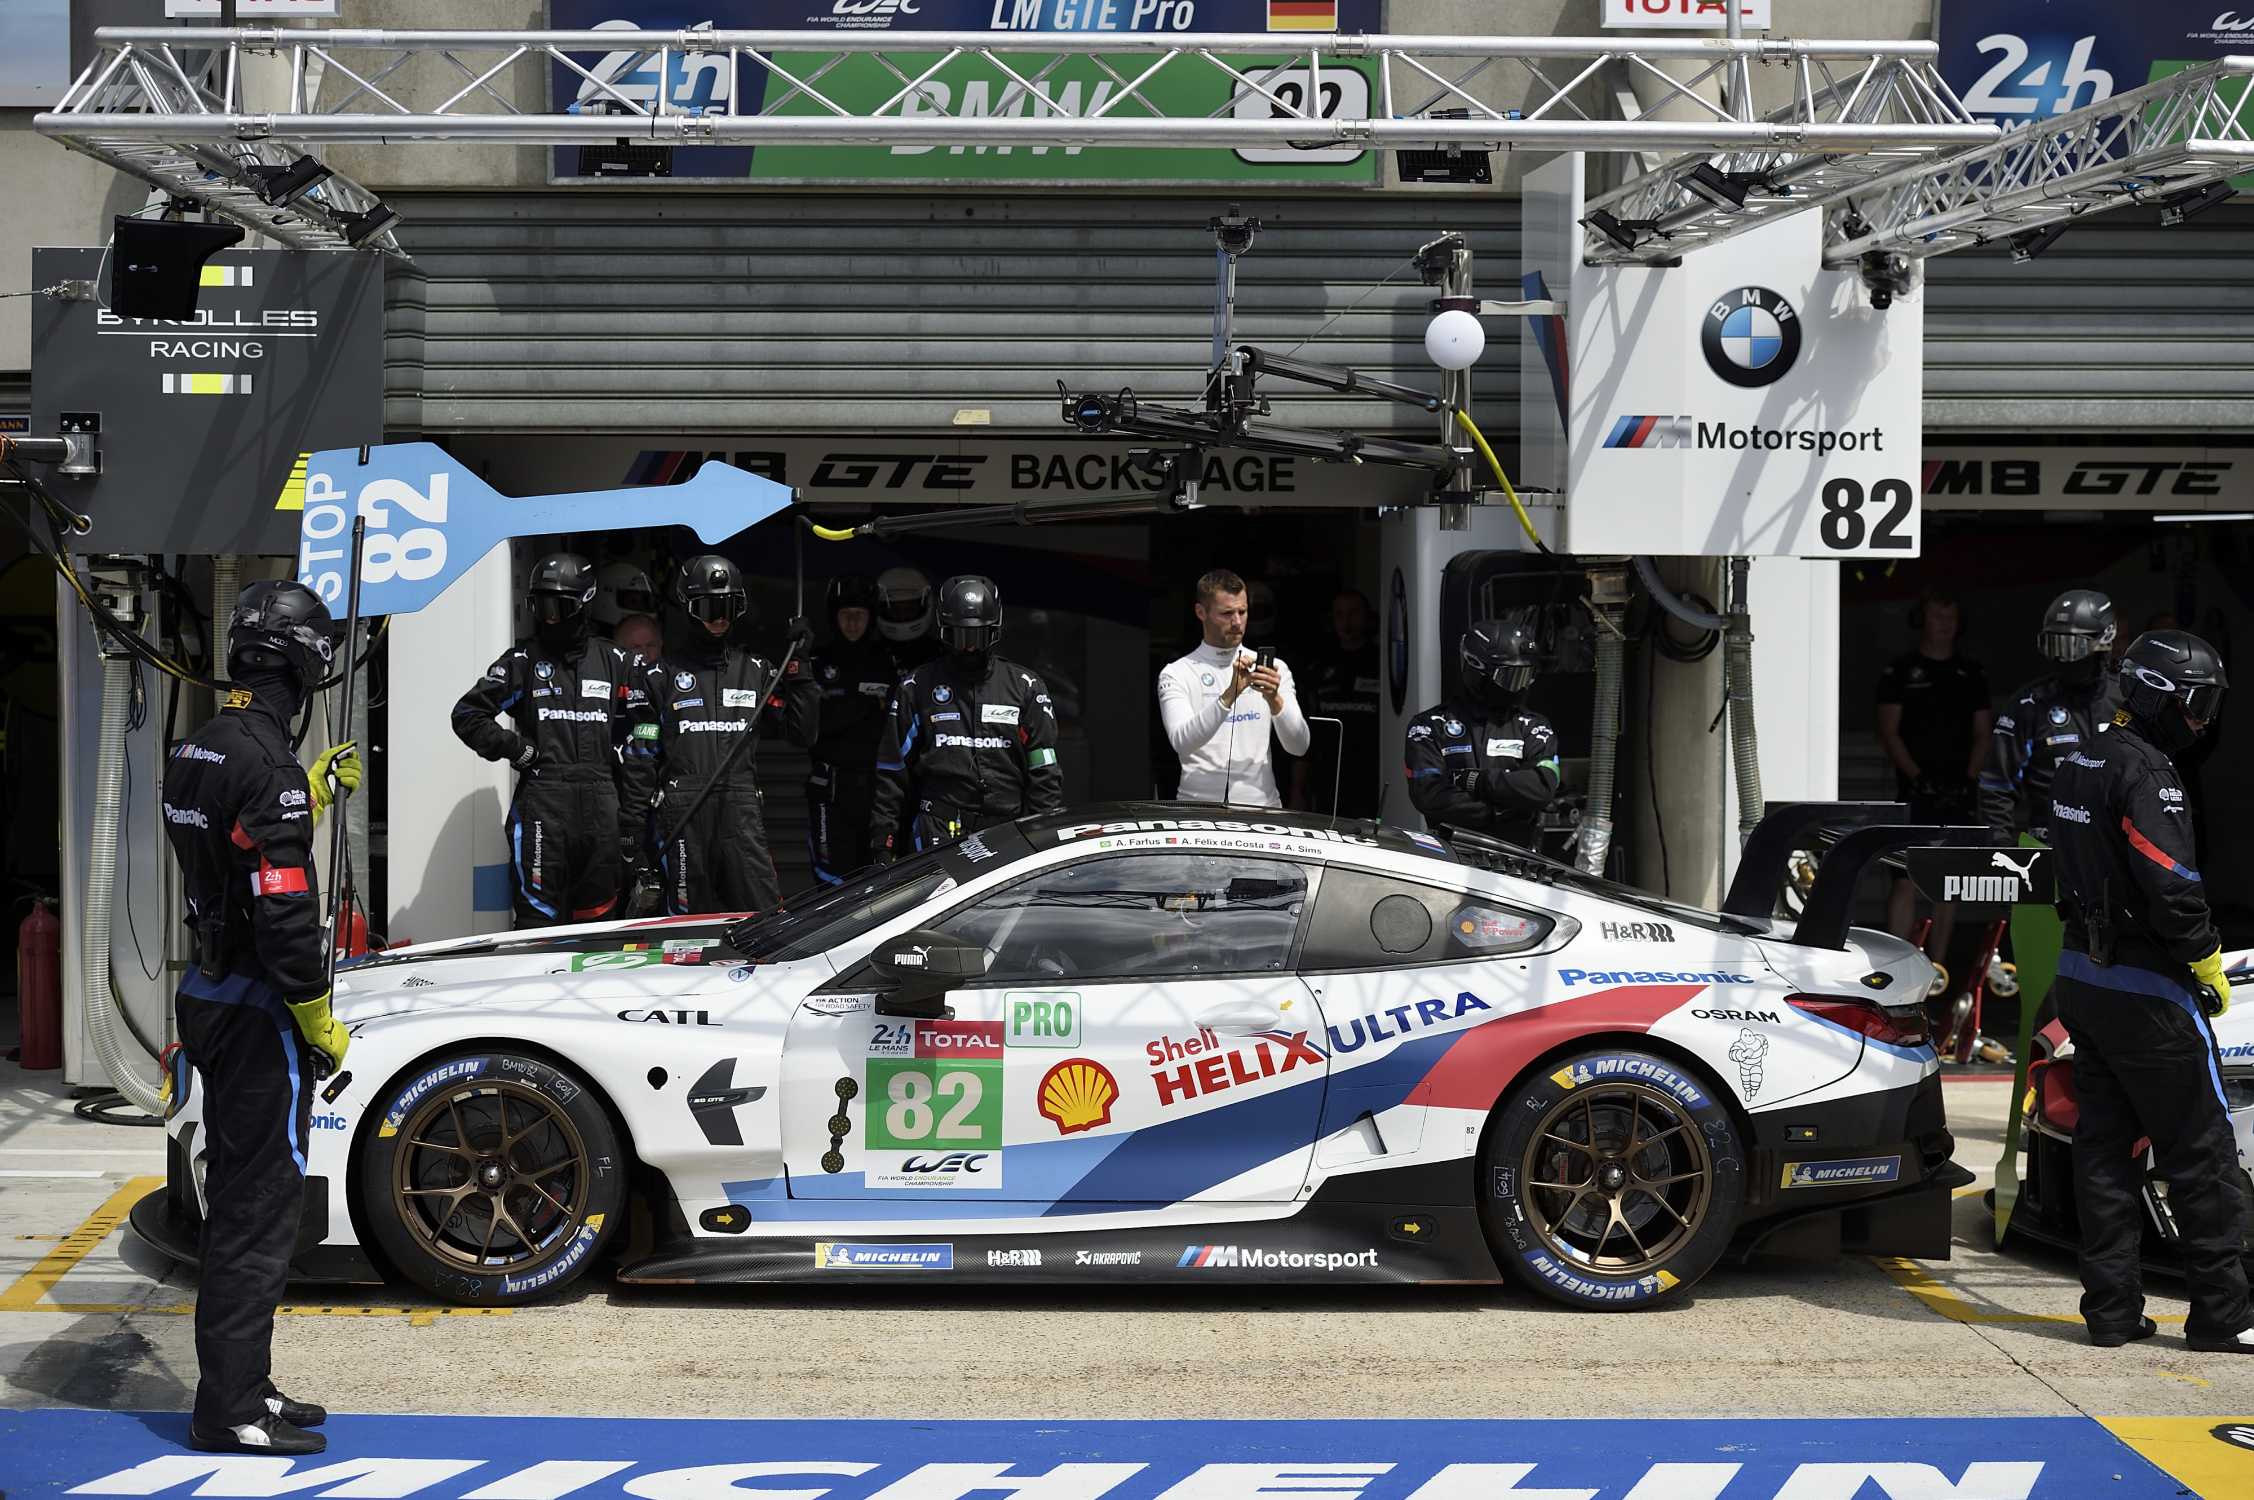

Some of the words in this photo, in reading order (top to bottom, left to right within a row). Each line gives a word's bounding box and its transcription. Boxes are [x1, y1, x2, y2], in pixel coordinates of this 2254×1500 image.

[990, 0, 1039, 30] LM
[1053, 0, 1117, 30] GTE
[1130, 0, 1195, 30] Pro
[1961, 33, 2114, 114] 24h
[1709, 289, 1796, 323] BMW
[151, 342, 264, 358] RACING
[1698, 422, 1883, 456] Motorsport
[809, 454, 987, 488] GTE
[1011, 453, 1295, 493] BACKSAGE
[1927, 460, 2040, 495] M8
[2062, 462, 2233, 495] GTE
[1820, 478, 1913, 549] 82
[301, 472, 347, 602] STOP
[357, 472, 449, 584] 82
[538, 708, 608, 722] Panasonic
[679, 718, 752, 733] Panasoni
[935, 733, 1012, 748] Panasonic
[534, 821, 542, 866] Motorsport
[1057, 820, 1379, 847] Panasonic
[1129, 838, 1161, 846] Farfus
[1235, 840, 1264, 849] Costa
[1298, 845, 1322, 855] Sims
[678, 839, 688, 887] Motorsport
[1944, 876, 2019, 901] PUMA
[1601, 921, 1645, 942] H&R
[895, 953, 923, 966] PUMA
[1558, 969, 1755, 986] Panasonic
[617, 1010, 723, 1026] CATL
[1013, 1001, 1073, 1036] PRO
[1691, 1009, 1781, 1024] OSRAM
[870, 1024, 911, 1044] 24h
[919, 1031, 1000, 1048] TOTAL
[1146, 1027, 1220, 1067] Shell
[1151, 1030, 1325, 1107] HELIX
[1327, 991, 1492, 1053] ULTRA
[399, 1060, 479, 1110] MICHELIN
[1596, 1059, 1701, 1103] MICHELIN
[885, 1071, 983, 1140] 82
[1466, 1126, 1475, 1135] 82
[901, 1152, 989, 1172] WEC
[1815, 1165, 1889, 1179] MICHELIN
[507, 1241, 586, 1293] MICHELIN
[854, 1252, 940, 1263] MICHELIN
[987, 1250, 1023, 1266] H&R
[1241, 1248, 1378, 1271] Motorsport
[1531, 1255, 1636, 1300] MICHELIN
[62, 1455, 2046, 1500] MICHELIN
